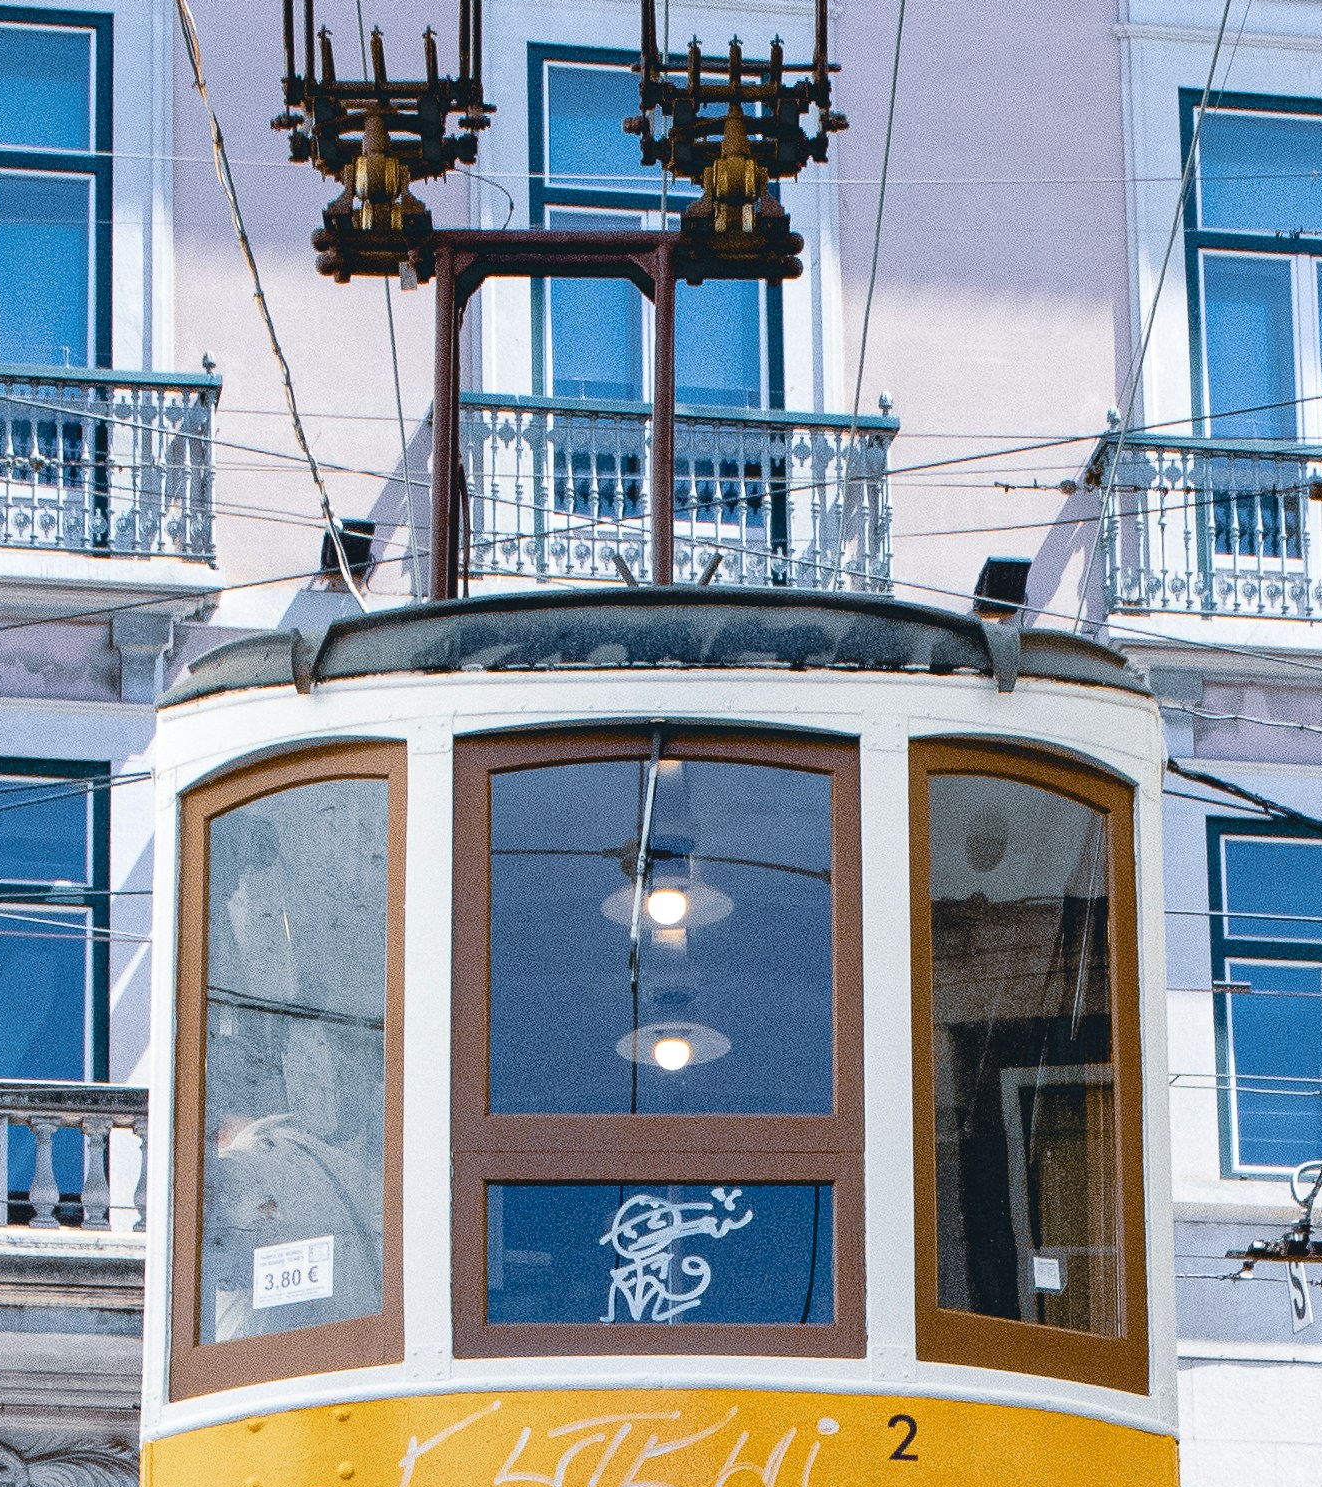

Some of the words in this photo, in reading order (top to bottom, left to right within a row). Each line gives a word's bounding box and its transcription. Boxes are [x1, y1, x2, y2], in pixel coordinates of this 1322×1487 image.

[264, 1269, 301, 1291] 3.80
[308, 1265, 319, 1283] €
[888, 1414, 918, 1461] 2
